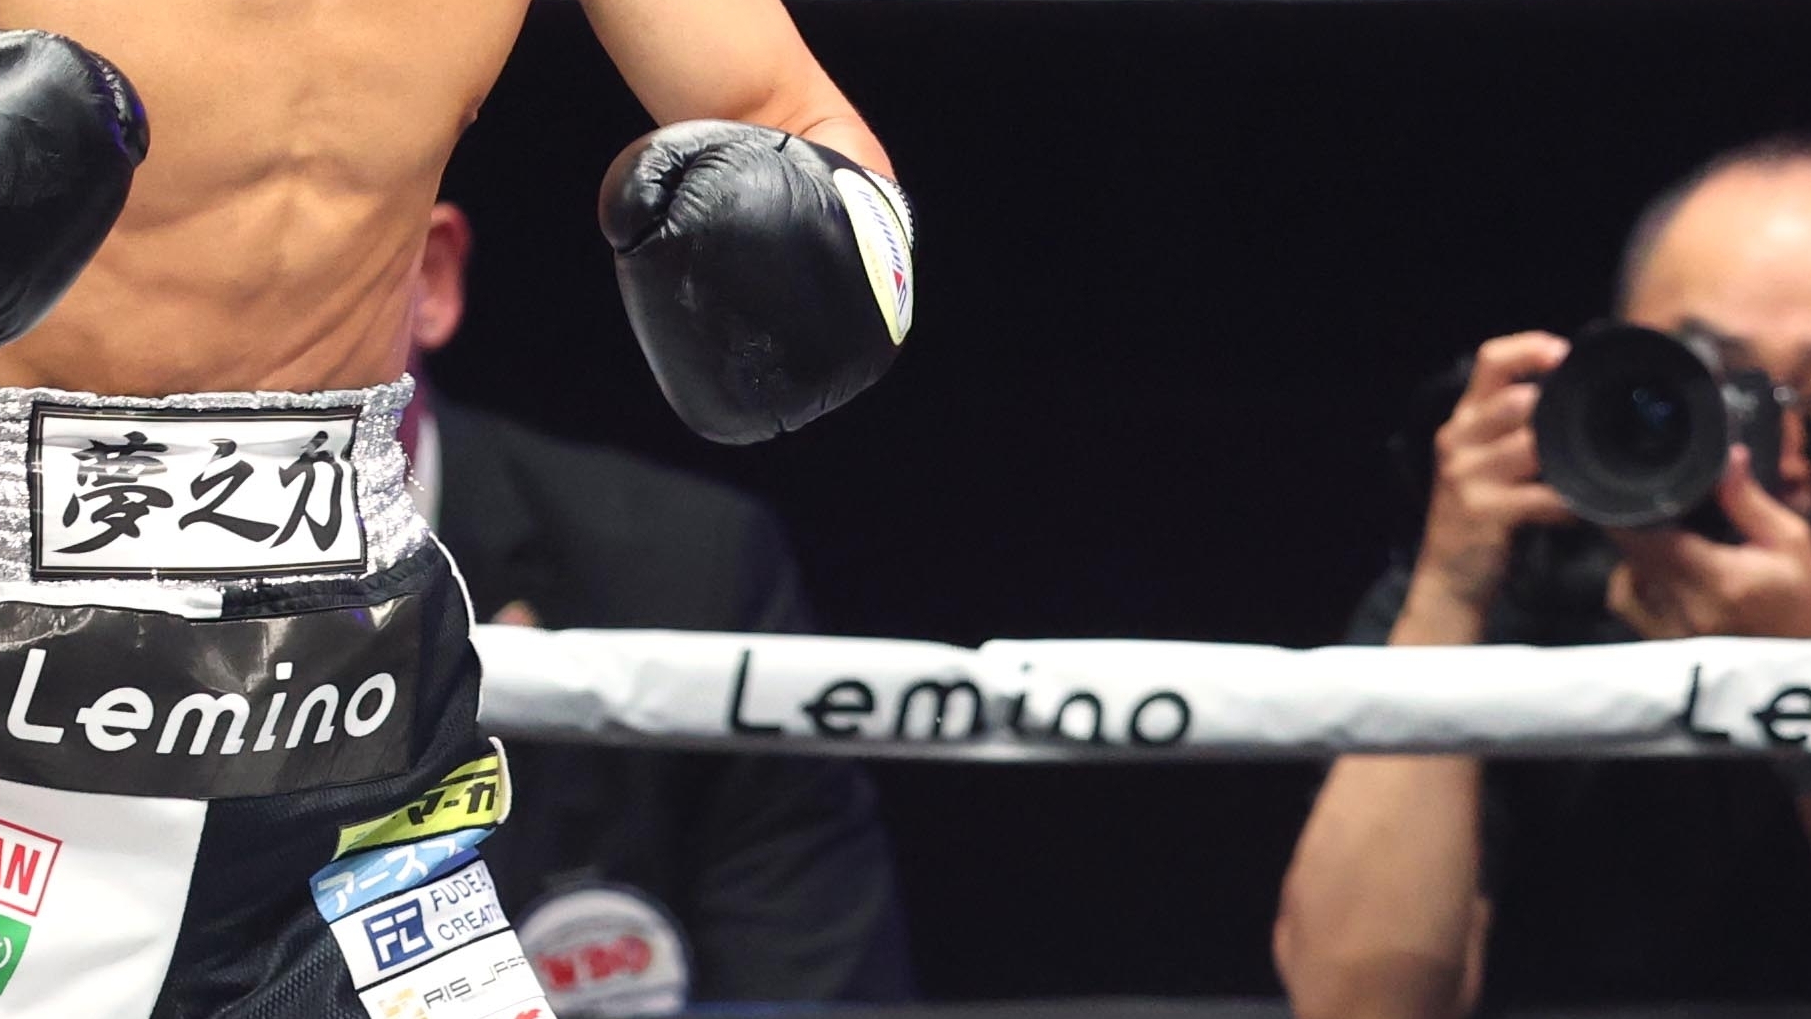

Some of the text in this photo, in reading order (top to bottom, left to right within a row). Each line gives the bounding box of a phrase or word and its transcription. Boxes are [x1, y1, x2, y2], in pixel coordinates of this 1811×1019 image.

[51, 430, 346, 554] 夢之力
[6, 648, 397, 756] Lemino
[729, 649, 1192, 745] Lemino
